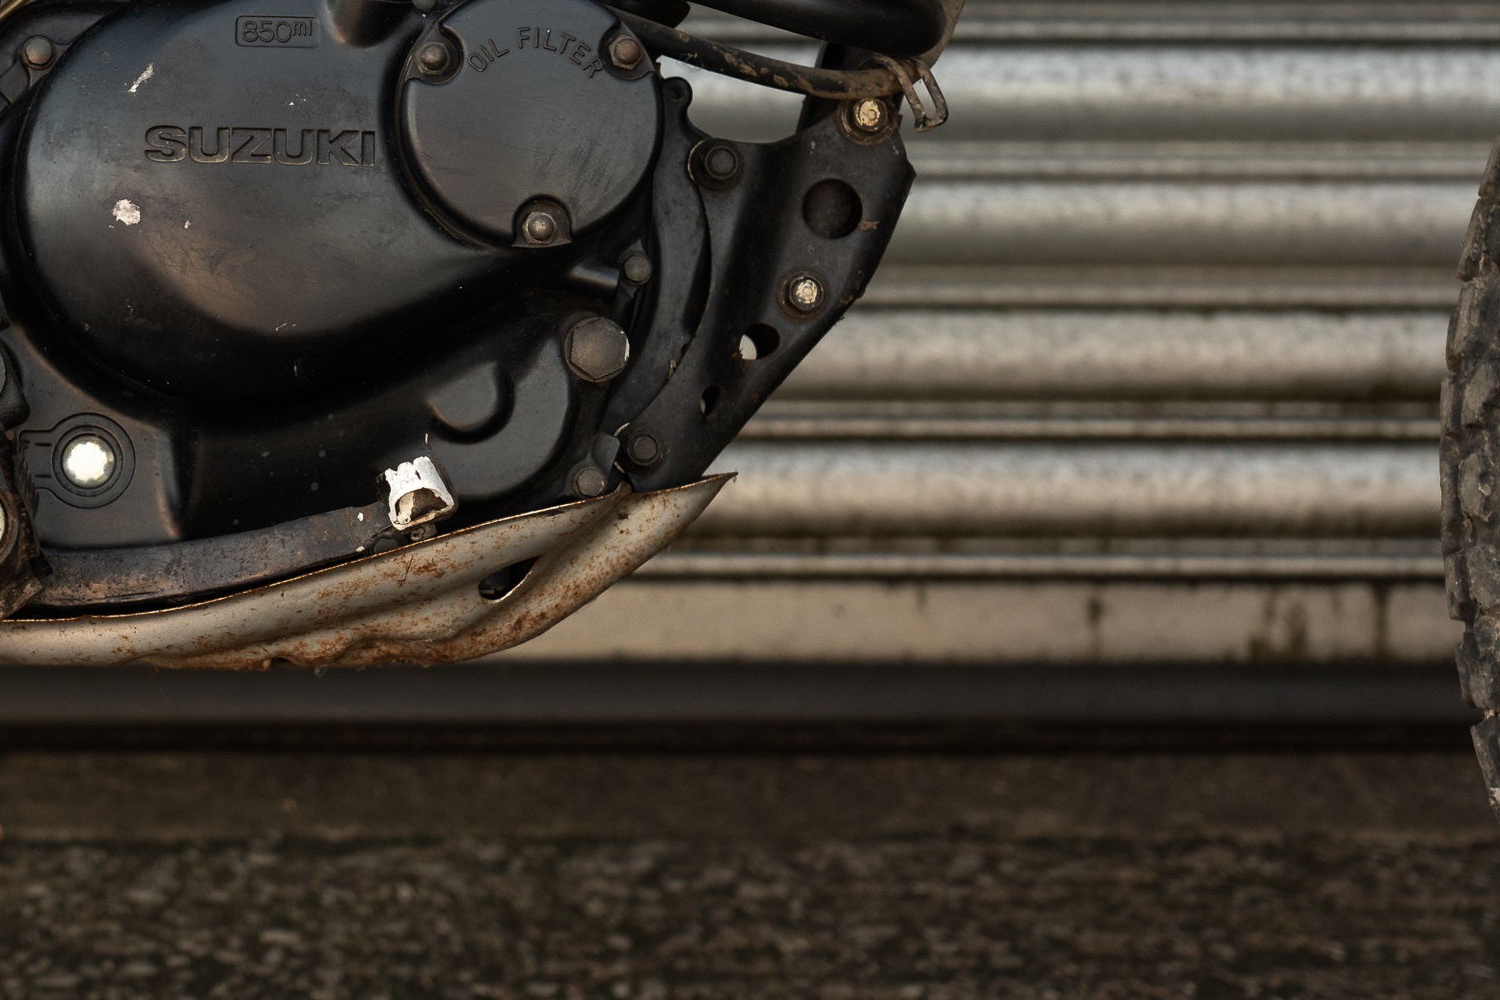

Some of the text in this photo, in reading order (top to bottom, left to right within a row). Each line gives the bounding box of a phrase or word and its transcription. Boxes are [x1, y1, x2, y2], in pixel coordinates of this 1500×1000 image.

[241, 19, 314, 44] 850ml
[467, 26, 605, 79] OIL FILTER
[143, 124, 376, 168] SUZUKI
